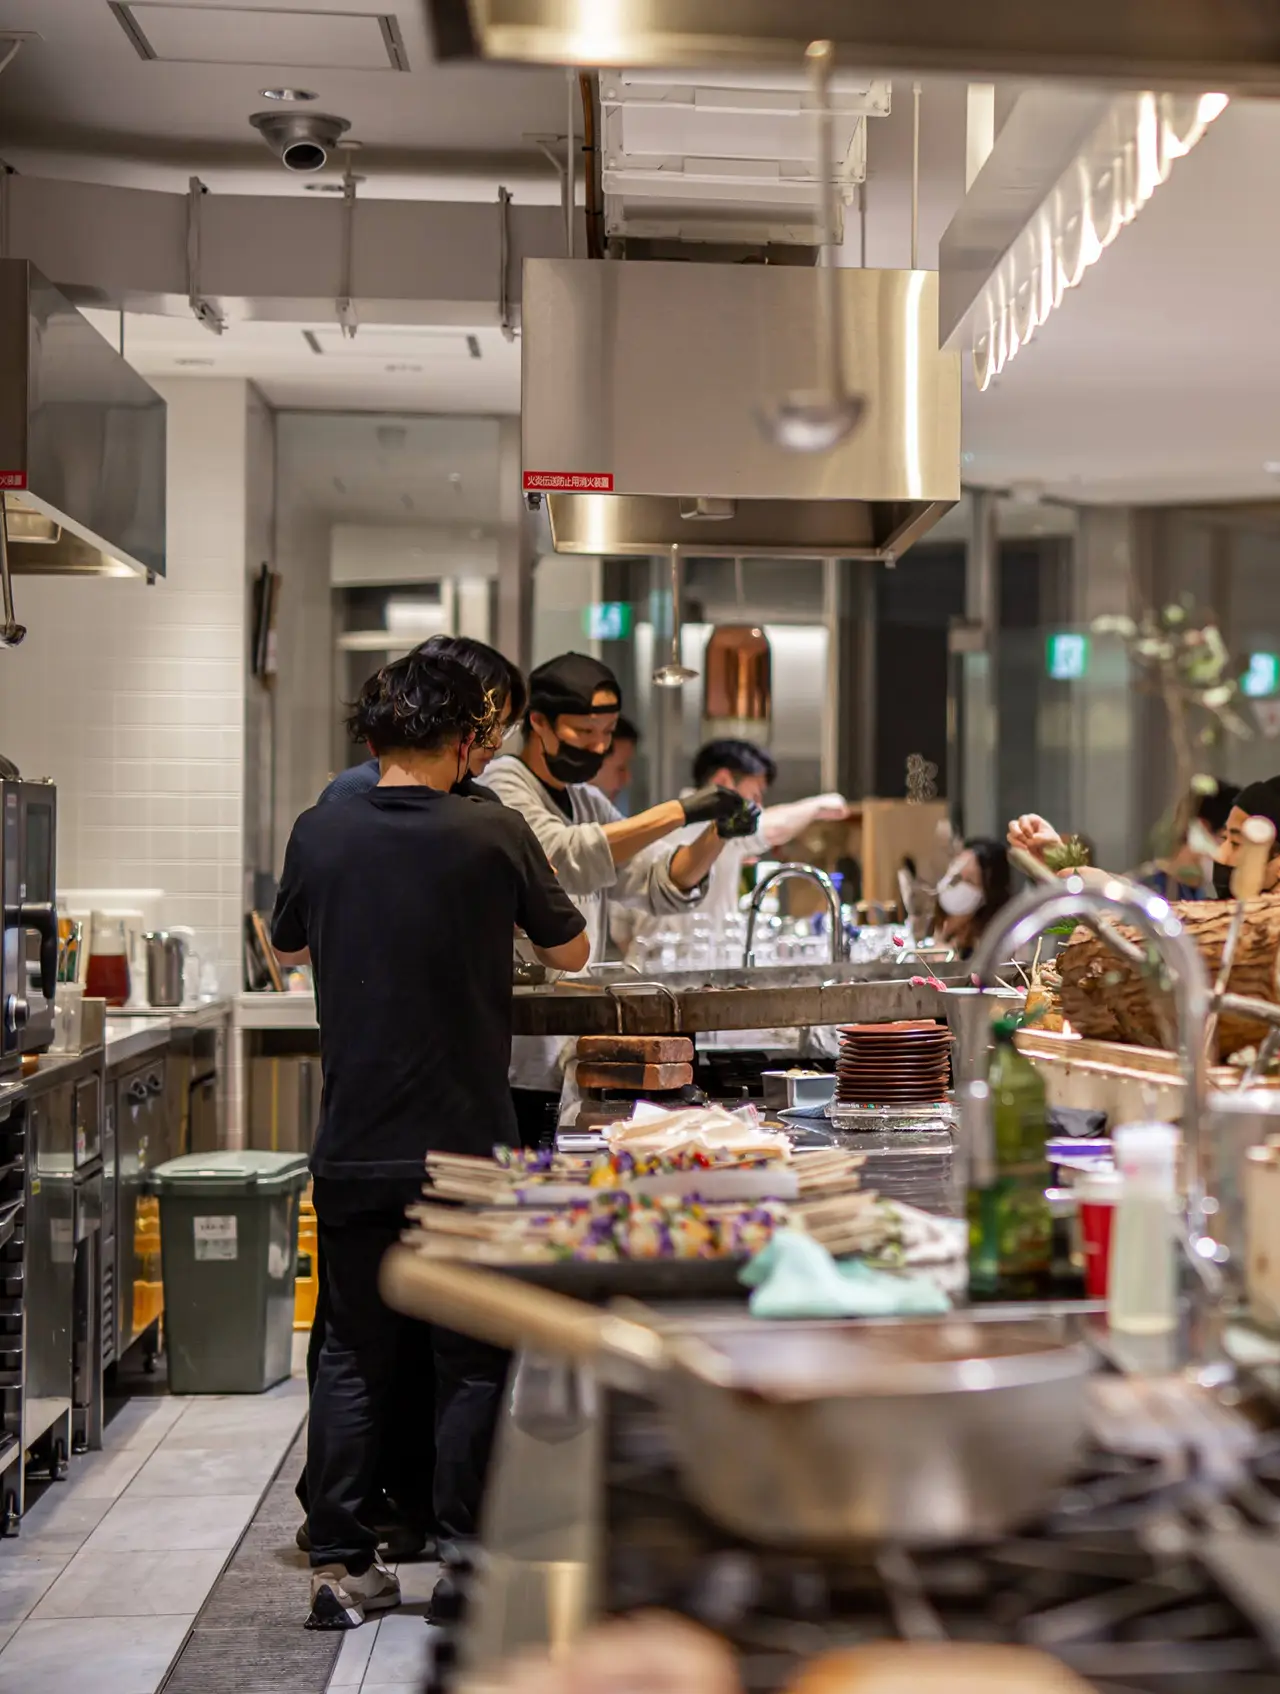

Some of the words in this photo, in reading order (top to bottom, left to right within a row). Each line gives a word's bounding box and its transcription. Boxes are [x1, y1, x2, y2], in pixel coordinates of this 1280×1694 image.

[527, 475, 609, 488] 火炎伝送防止用消火装置
